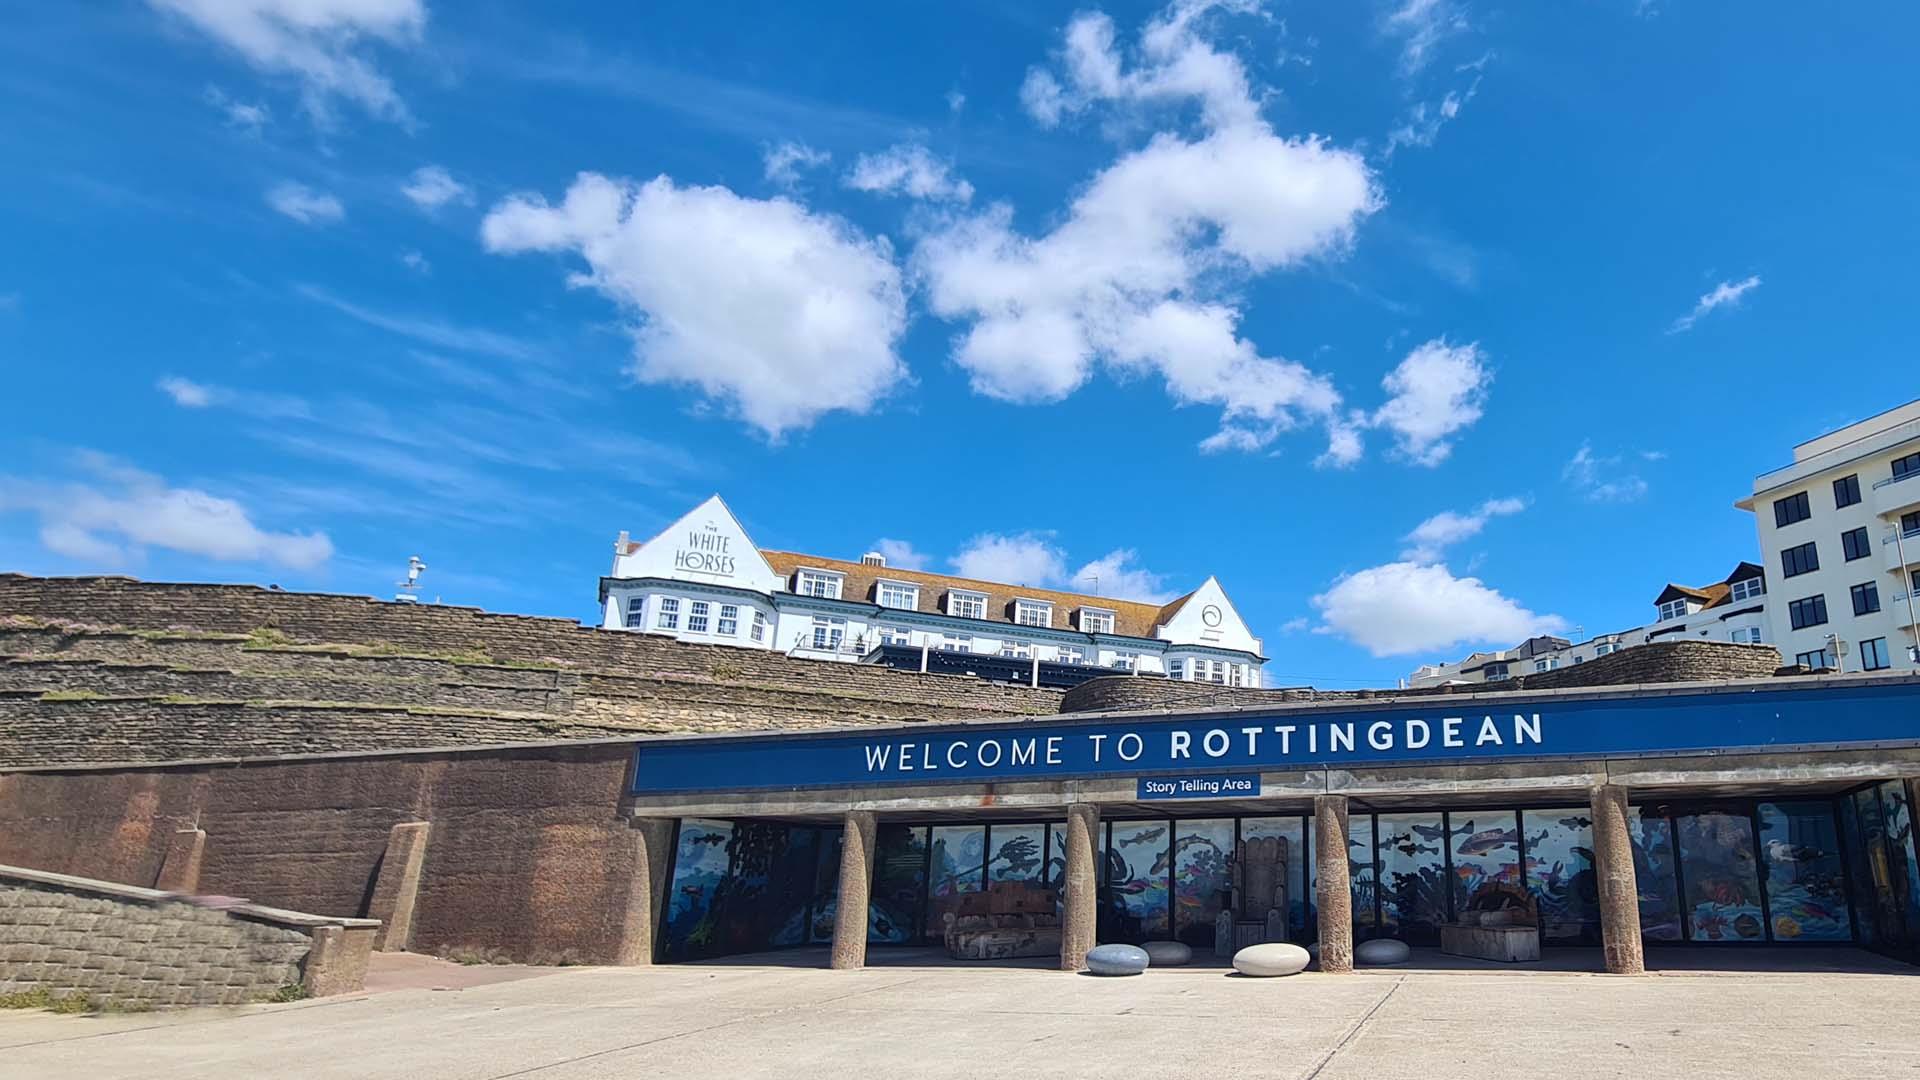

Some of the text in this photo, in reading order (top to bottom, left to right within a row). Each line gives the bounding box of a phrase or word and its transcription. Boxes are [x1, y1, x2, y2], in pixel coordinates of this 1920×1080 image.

[689, 531, 730, 553] WHITE
[675, 549, 735, 573] HORSES
[865, 713, 1542, 771] WELCOME TO ROTTINGDEAN
[1145, 779, 1252, 795] Story Telling Area
